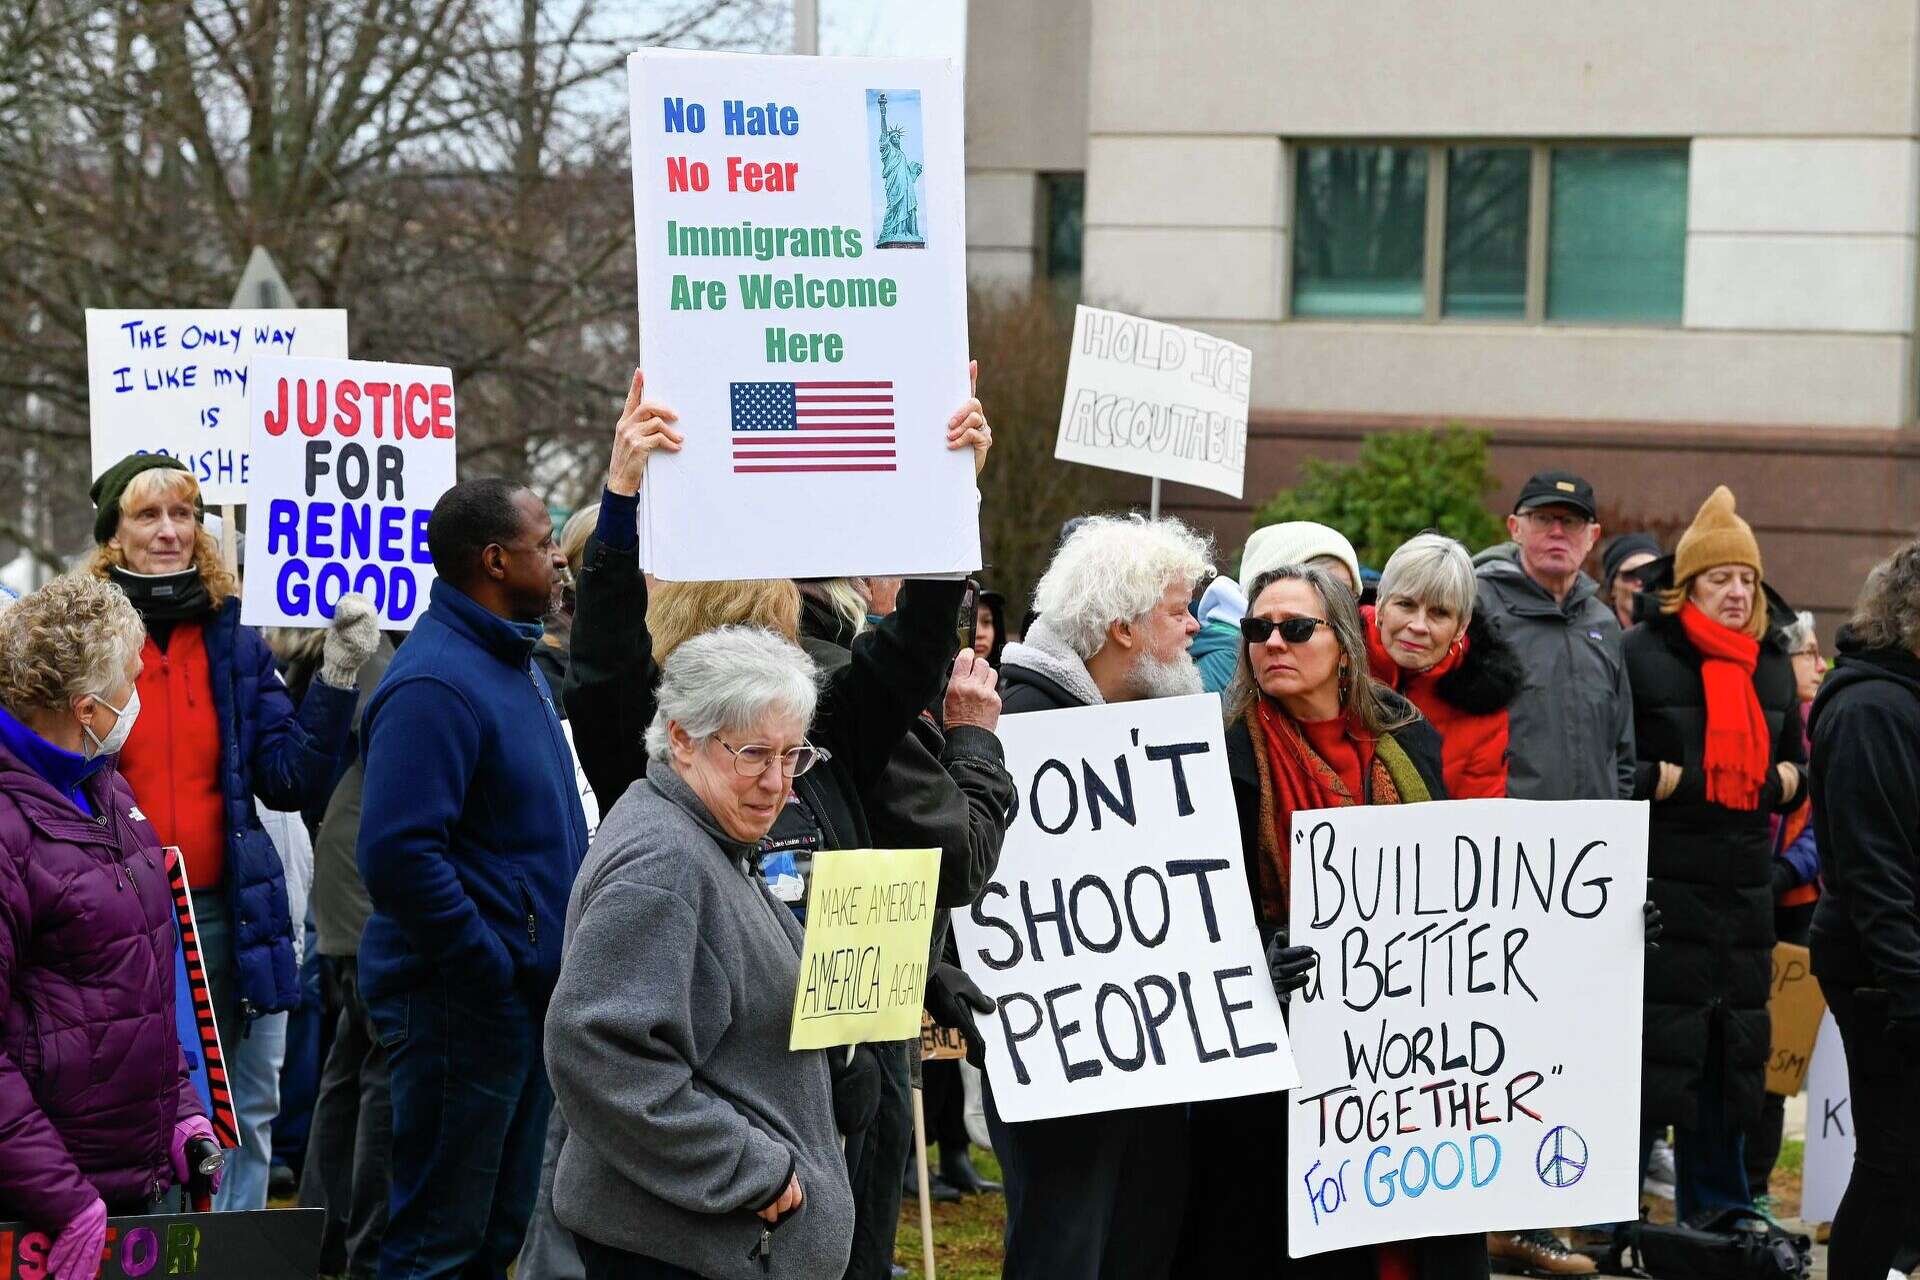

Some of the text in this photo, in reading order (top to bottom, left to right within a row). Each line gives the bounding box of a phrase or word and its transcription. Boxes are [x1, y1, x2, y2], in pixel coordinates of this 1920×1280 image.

[663, 97, 799, 136] No Hate
[666, 156, 798, 193] No Fear
[667, 220, 863, 261] Immigrants
[670, 273, 897, 310] Are Welcome
[121, 320, 296, 355] THE ONLY WAY
[765, 327, 844, 363] Here
[1083, 313, 1249, 402] HOLD ICE
[113, 367, 134, 392] I
[144, 365, 197, 390] LIKE
[264, 377, 455, 440] JUSTICE
[201, 407, 220, 427] IS
[1065, 388, 1248, 473] ACCOUTABLE
[305, 440, 404, 501] FOR
[268, 499, 433, 564] RENEE
[276, 558, 416, 621] GOOD
[819, 880, 927, 928] MAKE AMERICA
[971, 858, 1230, 971] SHOOT
[802, 946, 927, 1014] AMERICA AGAIN
[1342, 918, 1539, 1012] BETTER
[997, 965, 1278, 1085] PEOPLE
[1344, 1018, 1505, 1083] WORLD
[1364, 1133, 1502, 1207] GOOD
